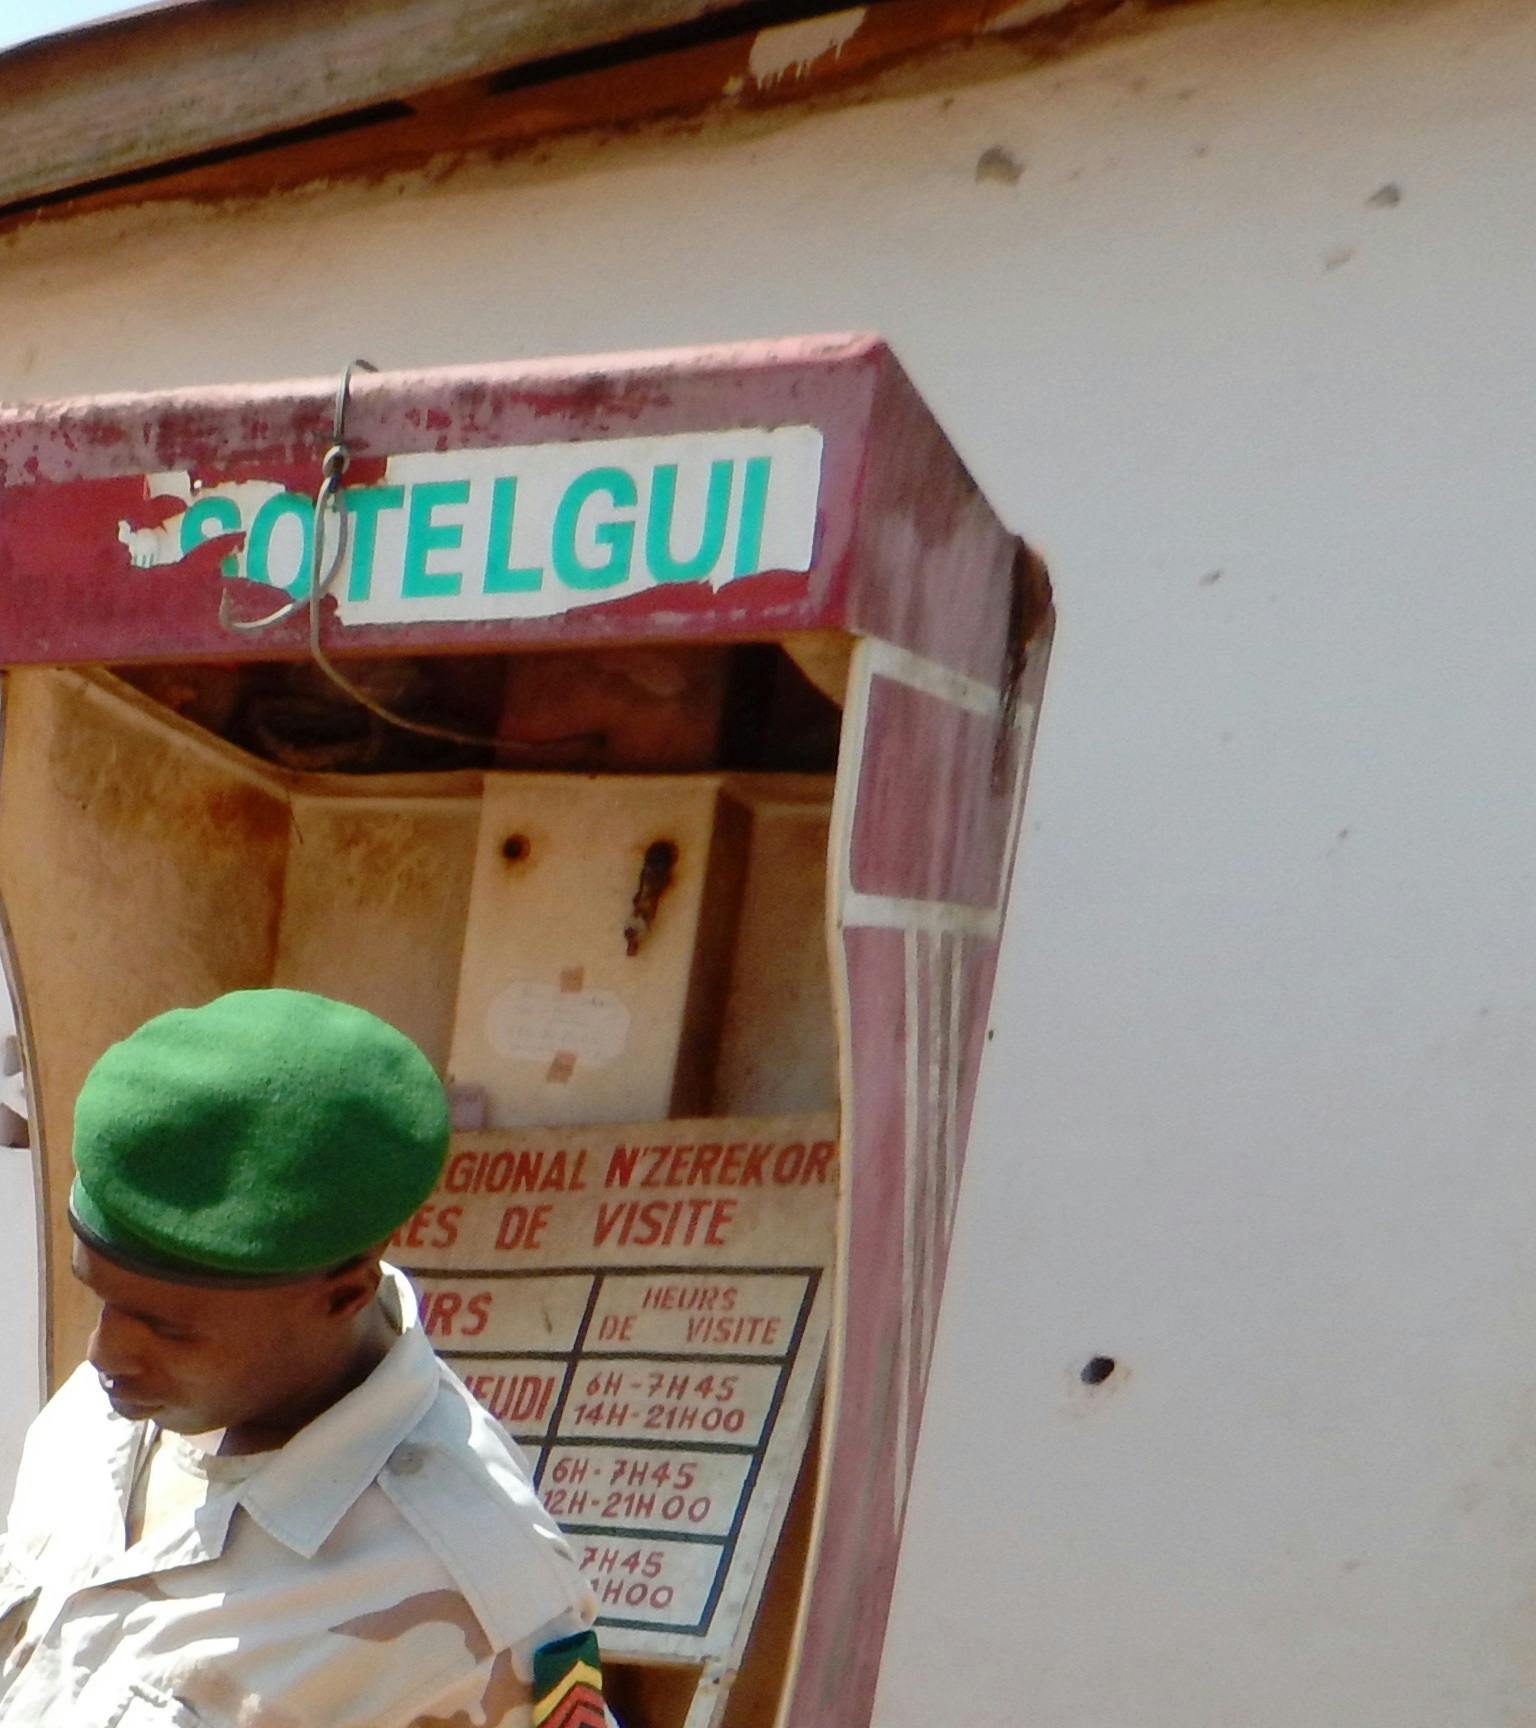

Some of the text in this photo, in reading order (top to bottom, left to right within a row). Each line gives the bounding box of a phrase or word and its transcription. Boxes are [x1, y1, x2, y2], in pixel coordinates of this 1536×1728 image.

[179, 456, 773, 603] SOTELGUI
[435, 1148, 587, 1194] GIONAL
[493, 1205, 553, 1250] DE
[592, 1199, 738, 1248] VISITE
[642, 1286, 738, 1313] HEURS
[597, 1314, 782, 1345] DE VISITE
